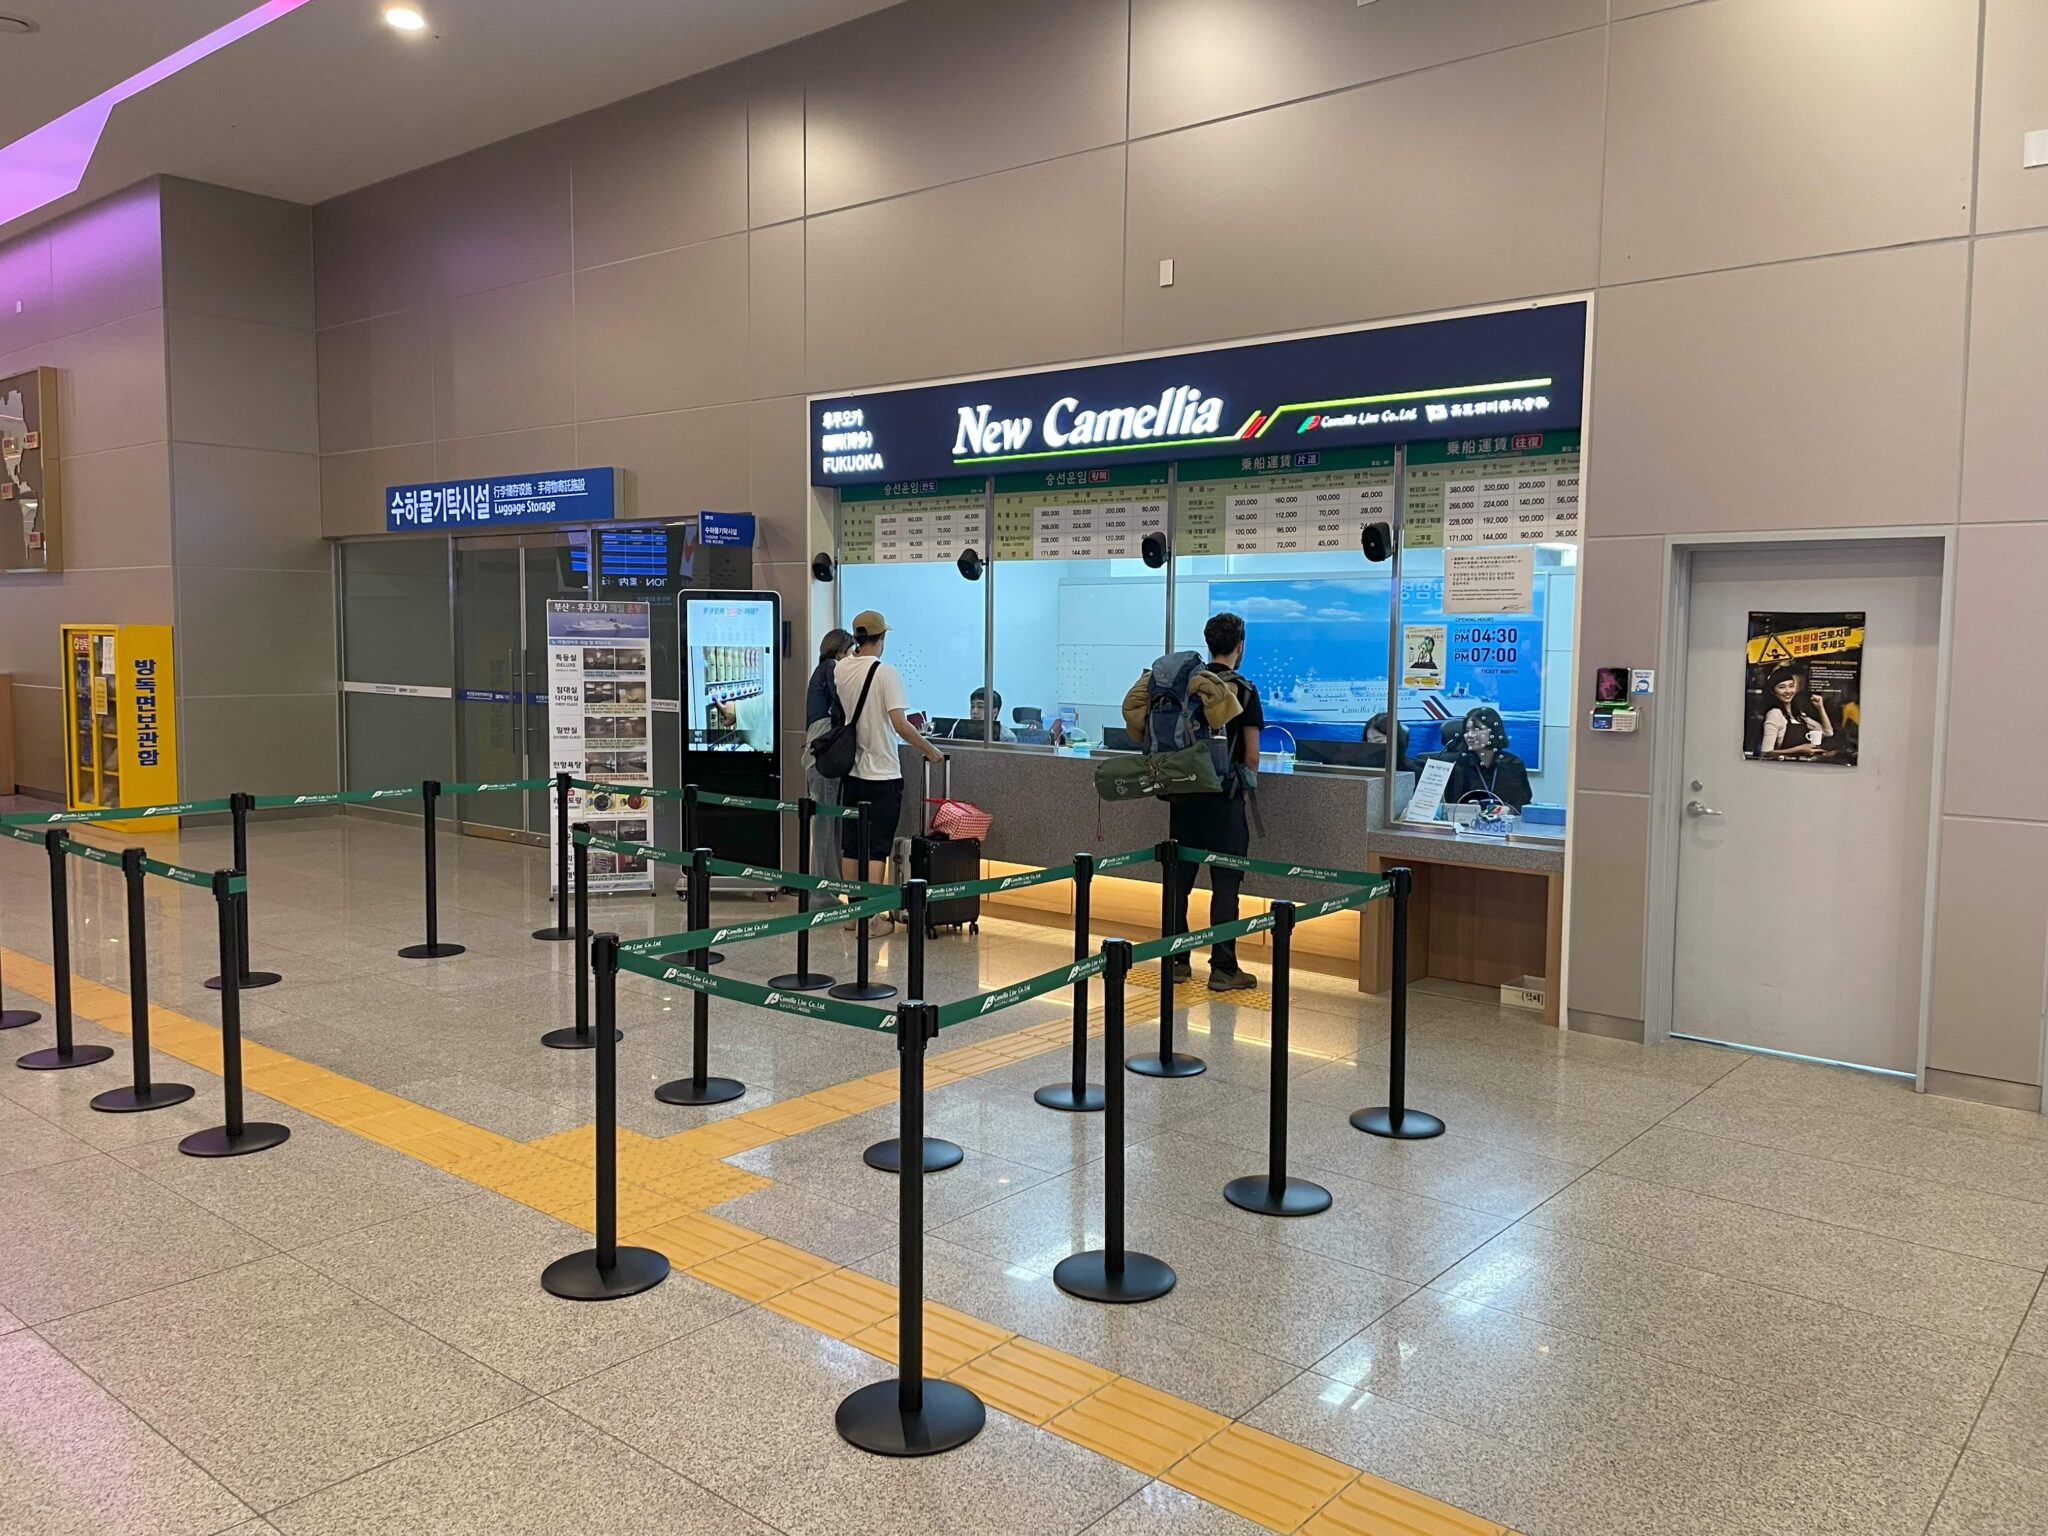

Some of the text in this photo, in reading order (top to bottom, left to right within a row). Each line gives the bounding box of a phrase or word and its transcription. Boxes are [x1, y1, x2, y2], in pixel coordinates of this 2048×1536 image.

[952, 385, 1224, 454] New Camellia
[822, 453, 884, 474] FUKUOKA
[1297, 454, 1317, 465] 片道
[1045, 471, 1087, 485] 승선운임
[884, 481, 919, 496] 승선운임
[1484, 484, 1509, 492] 320,000
[1519, 481, 1545, 489] 200,000
[1361, 491, 1383, 499] 40,000
[391, 484, 489, 525] 수하물기탁시설
[494, 500, 556, 514] Luggage Storage
[1484, 500, 1508, 508] 224,000
[1520, 498, 1544, 506] 140,000
[1275, 511, 1297, 519] 112,000
[1360, 506, 1382, 514] 28,000
[1277, 526, 1297, 534] 96,000
[1318, 524, 1339, 532] 60,000
[1521, 531, 1543, 539] 90,000
[1277, 541, 1296, 549] 72,000
[554, 602, 569, 612] 부산
[578, 602, 608, 613] 후쿠오카
[1454, 628, 1518, 643] PM 04:30
[1821, 640, 1845, 650] 주세요
[556, 654, 577, 662] 특등실
[1454, 648, 1517, 663] PM 07:00
[134, 659, 159, 767] 방독면보관함
